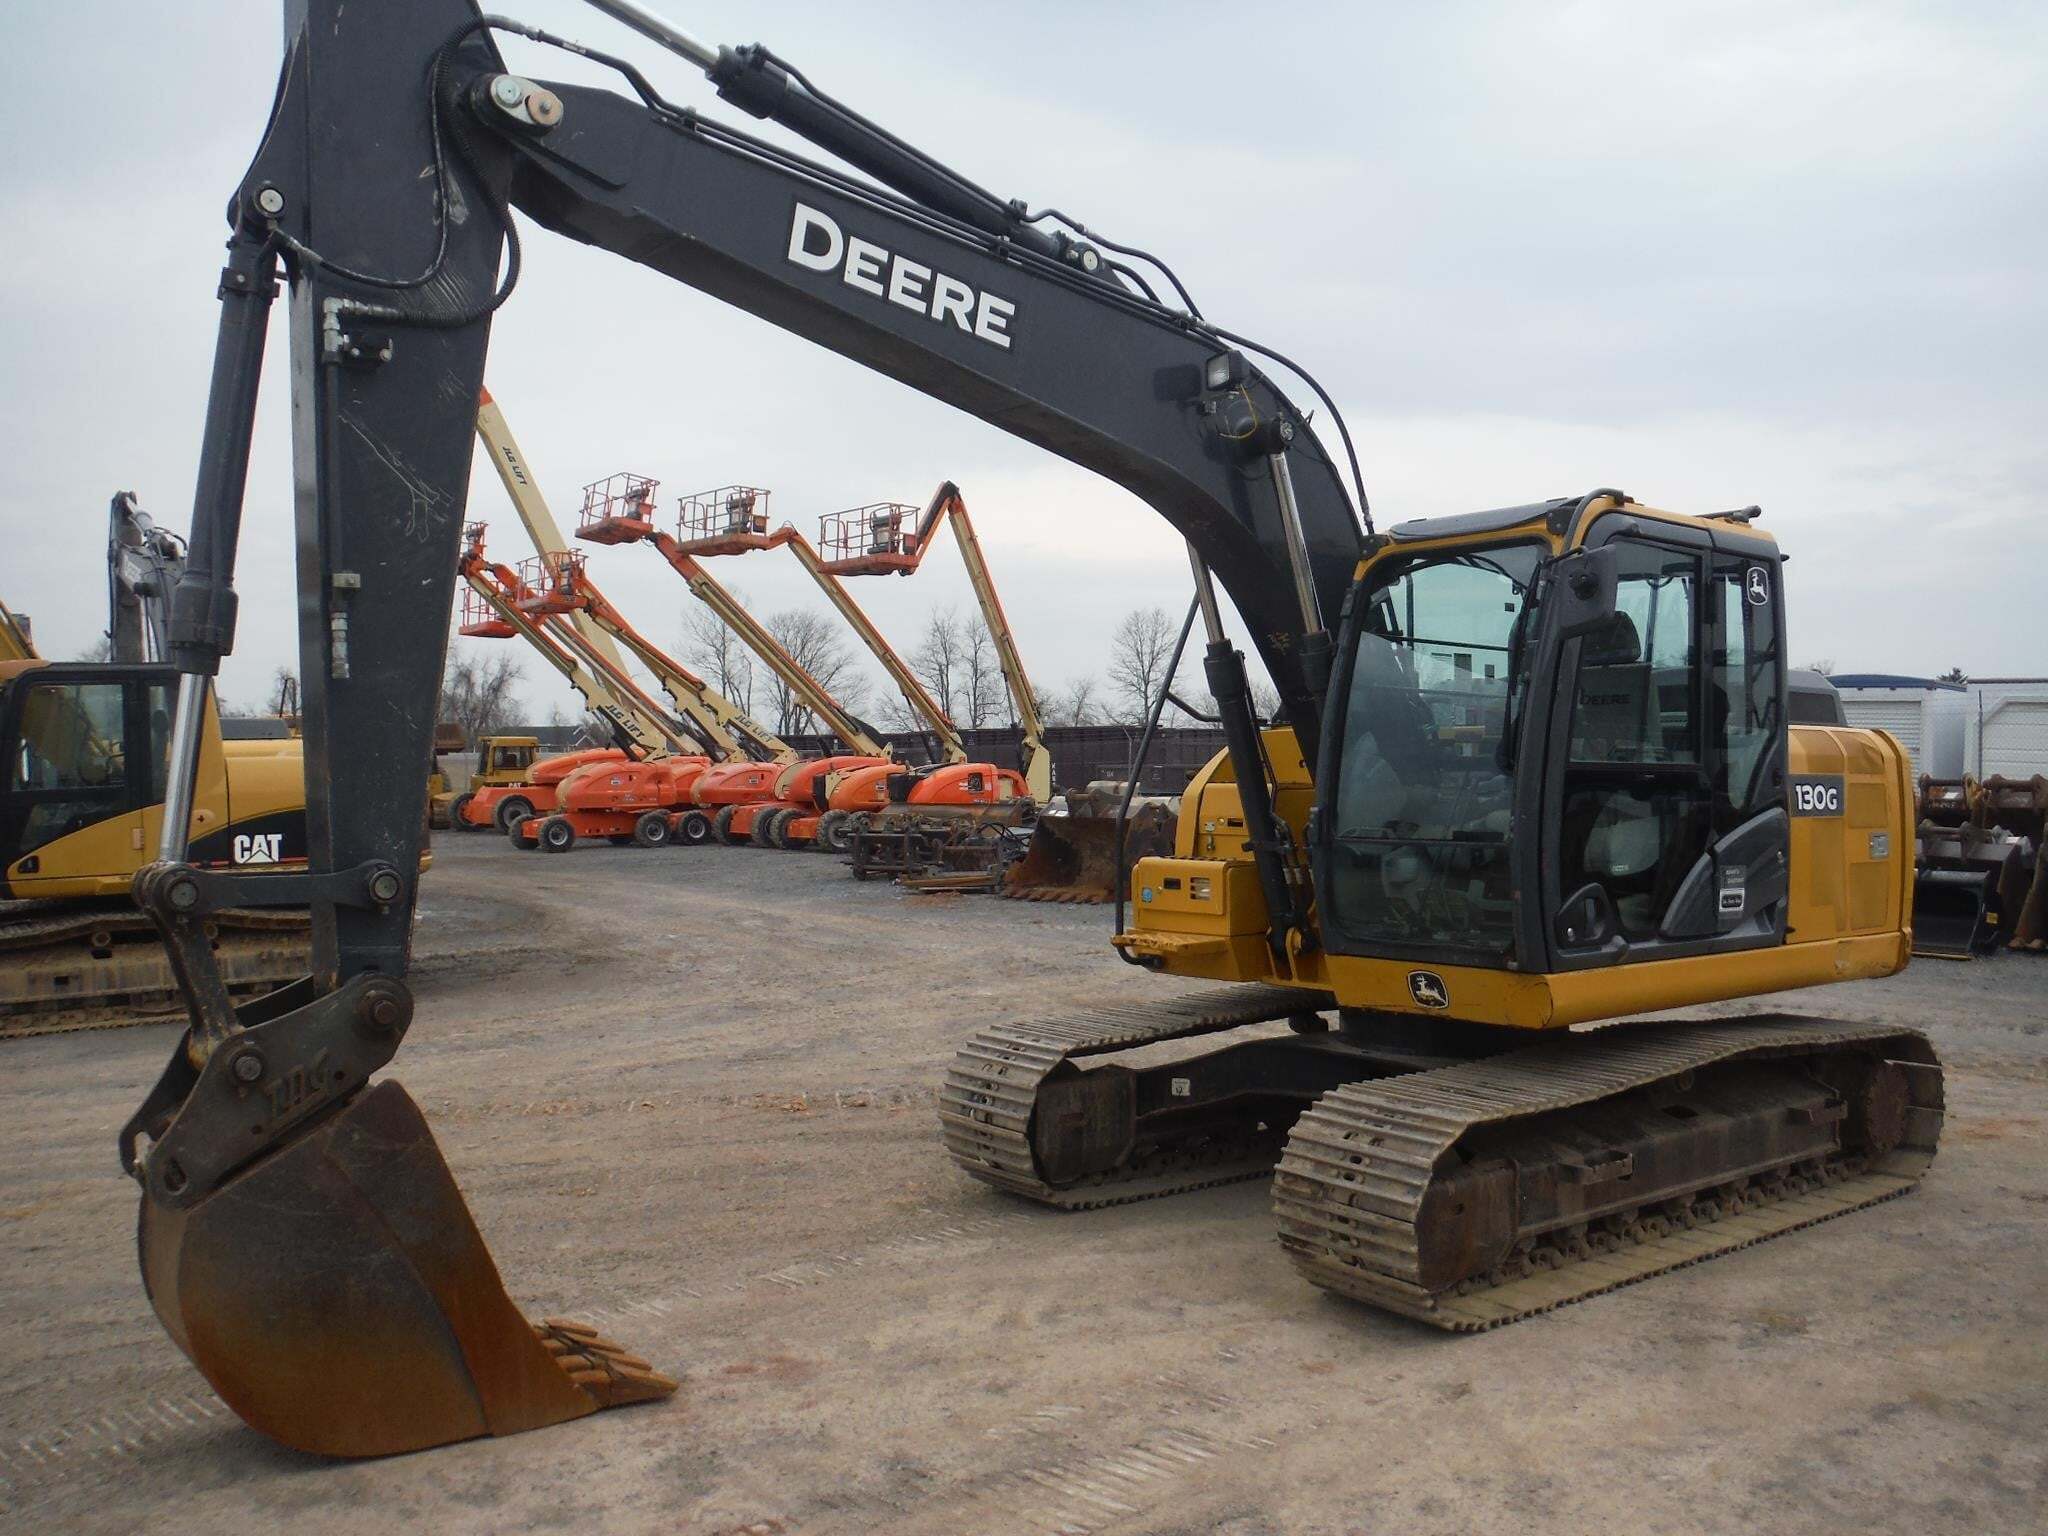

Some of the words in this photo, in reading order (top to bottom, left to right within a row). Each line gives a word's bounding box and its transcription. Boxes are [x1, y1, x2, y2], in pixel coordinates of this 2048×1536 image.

[787, 202, 1016, 348] DEERE
[502, 446, 517, 463] JLG
[512, 465, 528, 485] LIFT
[605, 704, 625, 719] JLG
[621, 719, 646, 738] LIFT
[735, 714, 753, 728] JLG
[752, 726, 775, 742] LIFT
[1795, 784, 1838, 810] 130G
[233, 834, 283, 864] CAT
